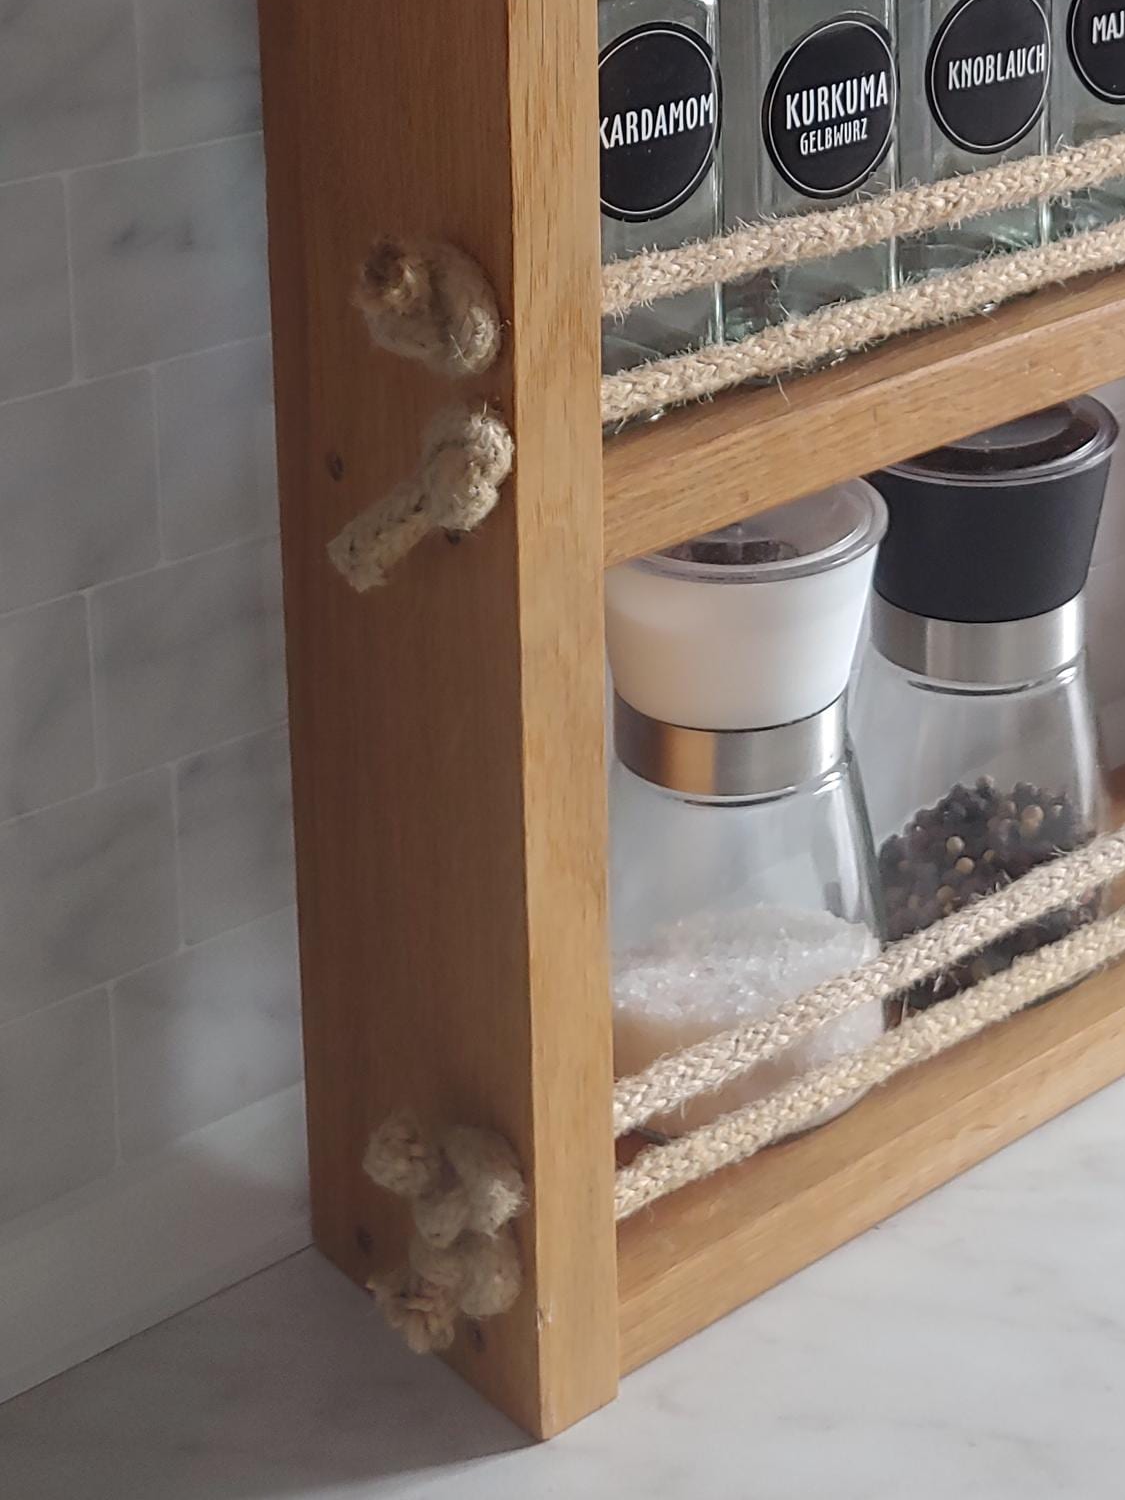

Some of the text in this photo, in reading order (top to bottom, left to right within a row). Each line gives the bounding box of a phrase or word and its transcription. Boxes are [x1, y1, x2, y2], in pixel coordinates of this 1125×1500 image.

[946, 43, 1045, 91] KNOBLAUCH
[600, 92, 714, 150] KARDAMOM
[785, 70, 888, 130] KURKUMA
[800, 118, 868, 156] GELBWURZ
